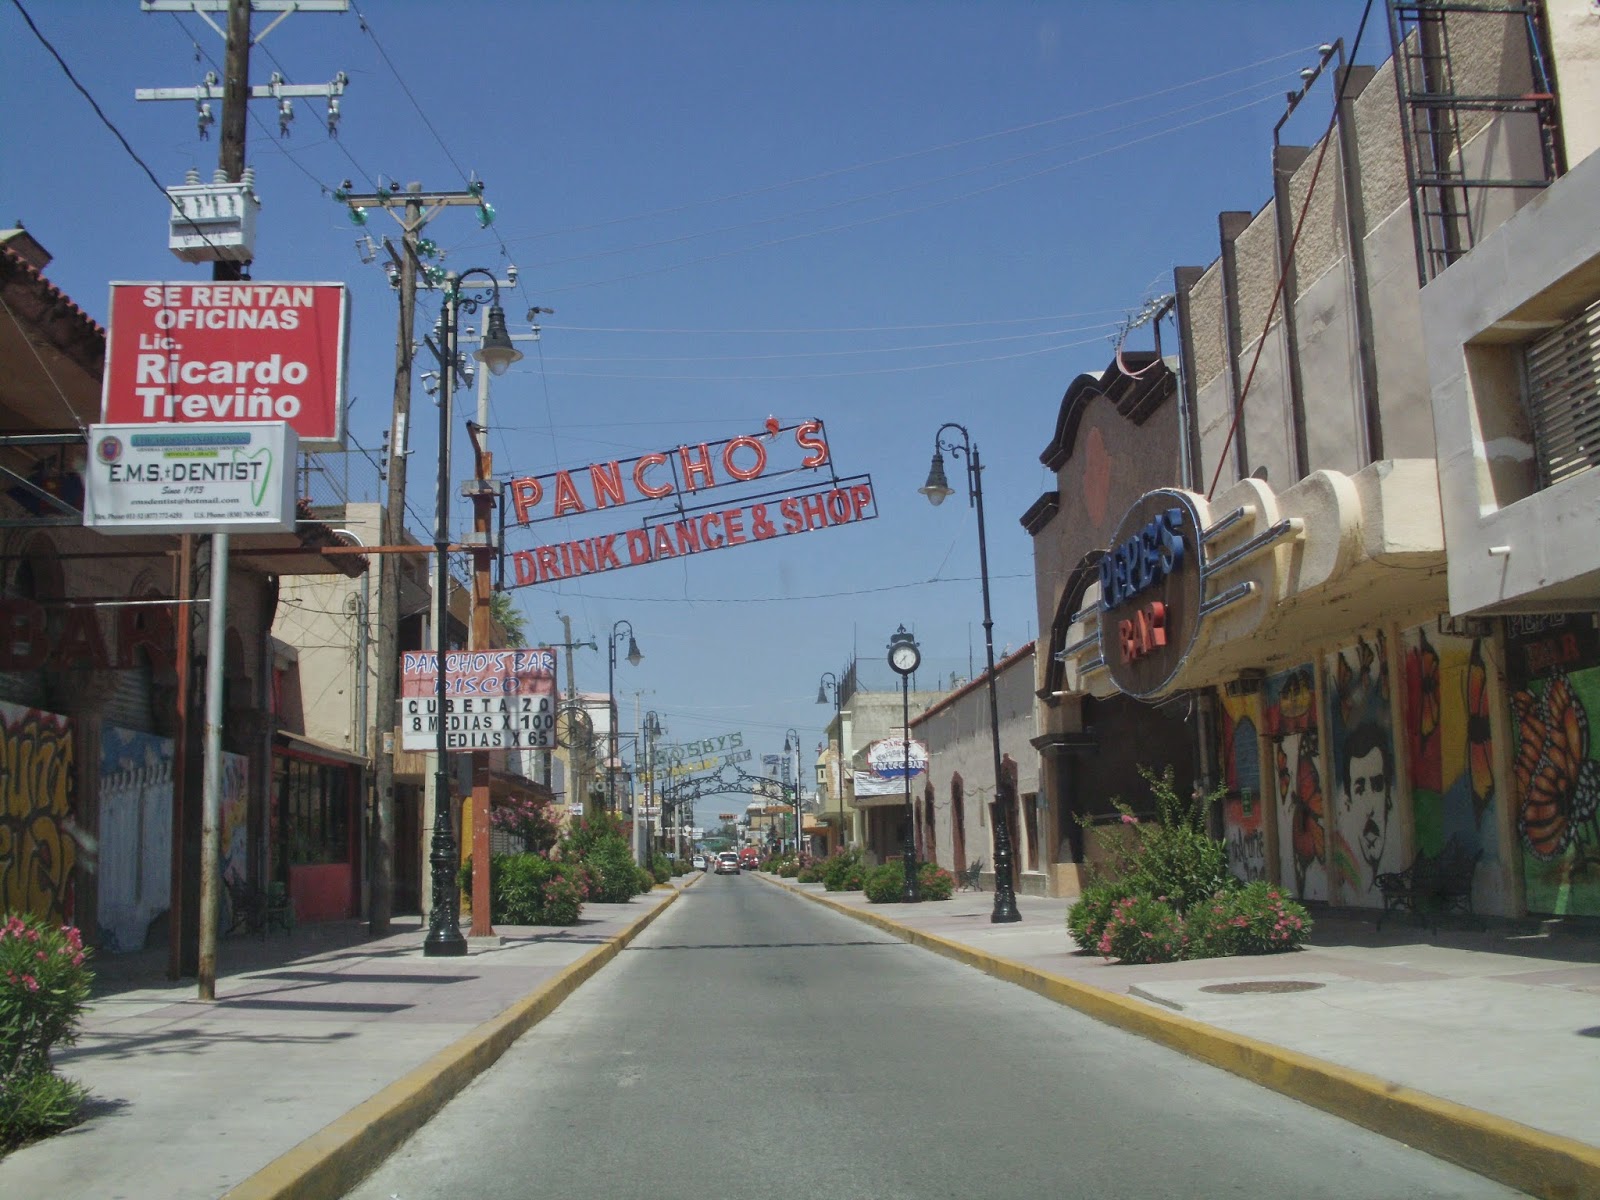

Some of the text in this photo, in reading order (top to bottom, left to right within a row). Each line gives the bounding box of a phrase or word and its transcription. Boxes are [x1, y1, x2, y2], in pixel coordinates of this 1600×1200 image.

[143, 286, 313, 307] SE RENTAN
[154, 308, 299, 330] OFICINAS
[139, 333, 183, 350] Lic.
[136, 353, 309, 385] Ricardo
[135, 386, 301, 418] Treviño
[108, 461, 262, 483] E.M.S. DENTIST
[511, 414, 829, 525] PANCHO'S
[161, 486, 181, 495] Since
[513, 484, 871, 587] DRINK DANCE & SHOP
[1118, 601, 1167, 666] BAR
[404, 652, 555, 675] PANCHO'S BAR
[412, 717, 422, 731] 8
[501, 716, 511, 730] X
[520, 714, 554, 730] 100
[437, 731, 548, 747] EDIAS X 65
